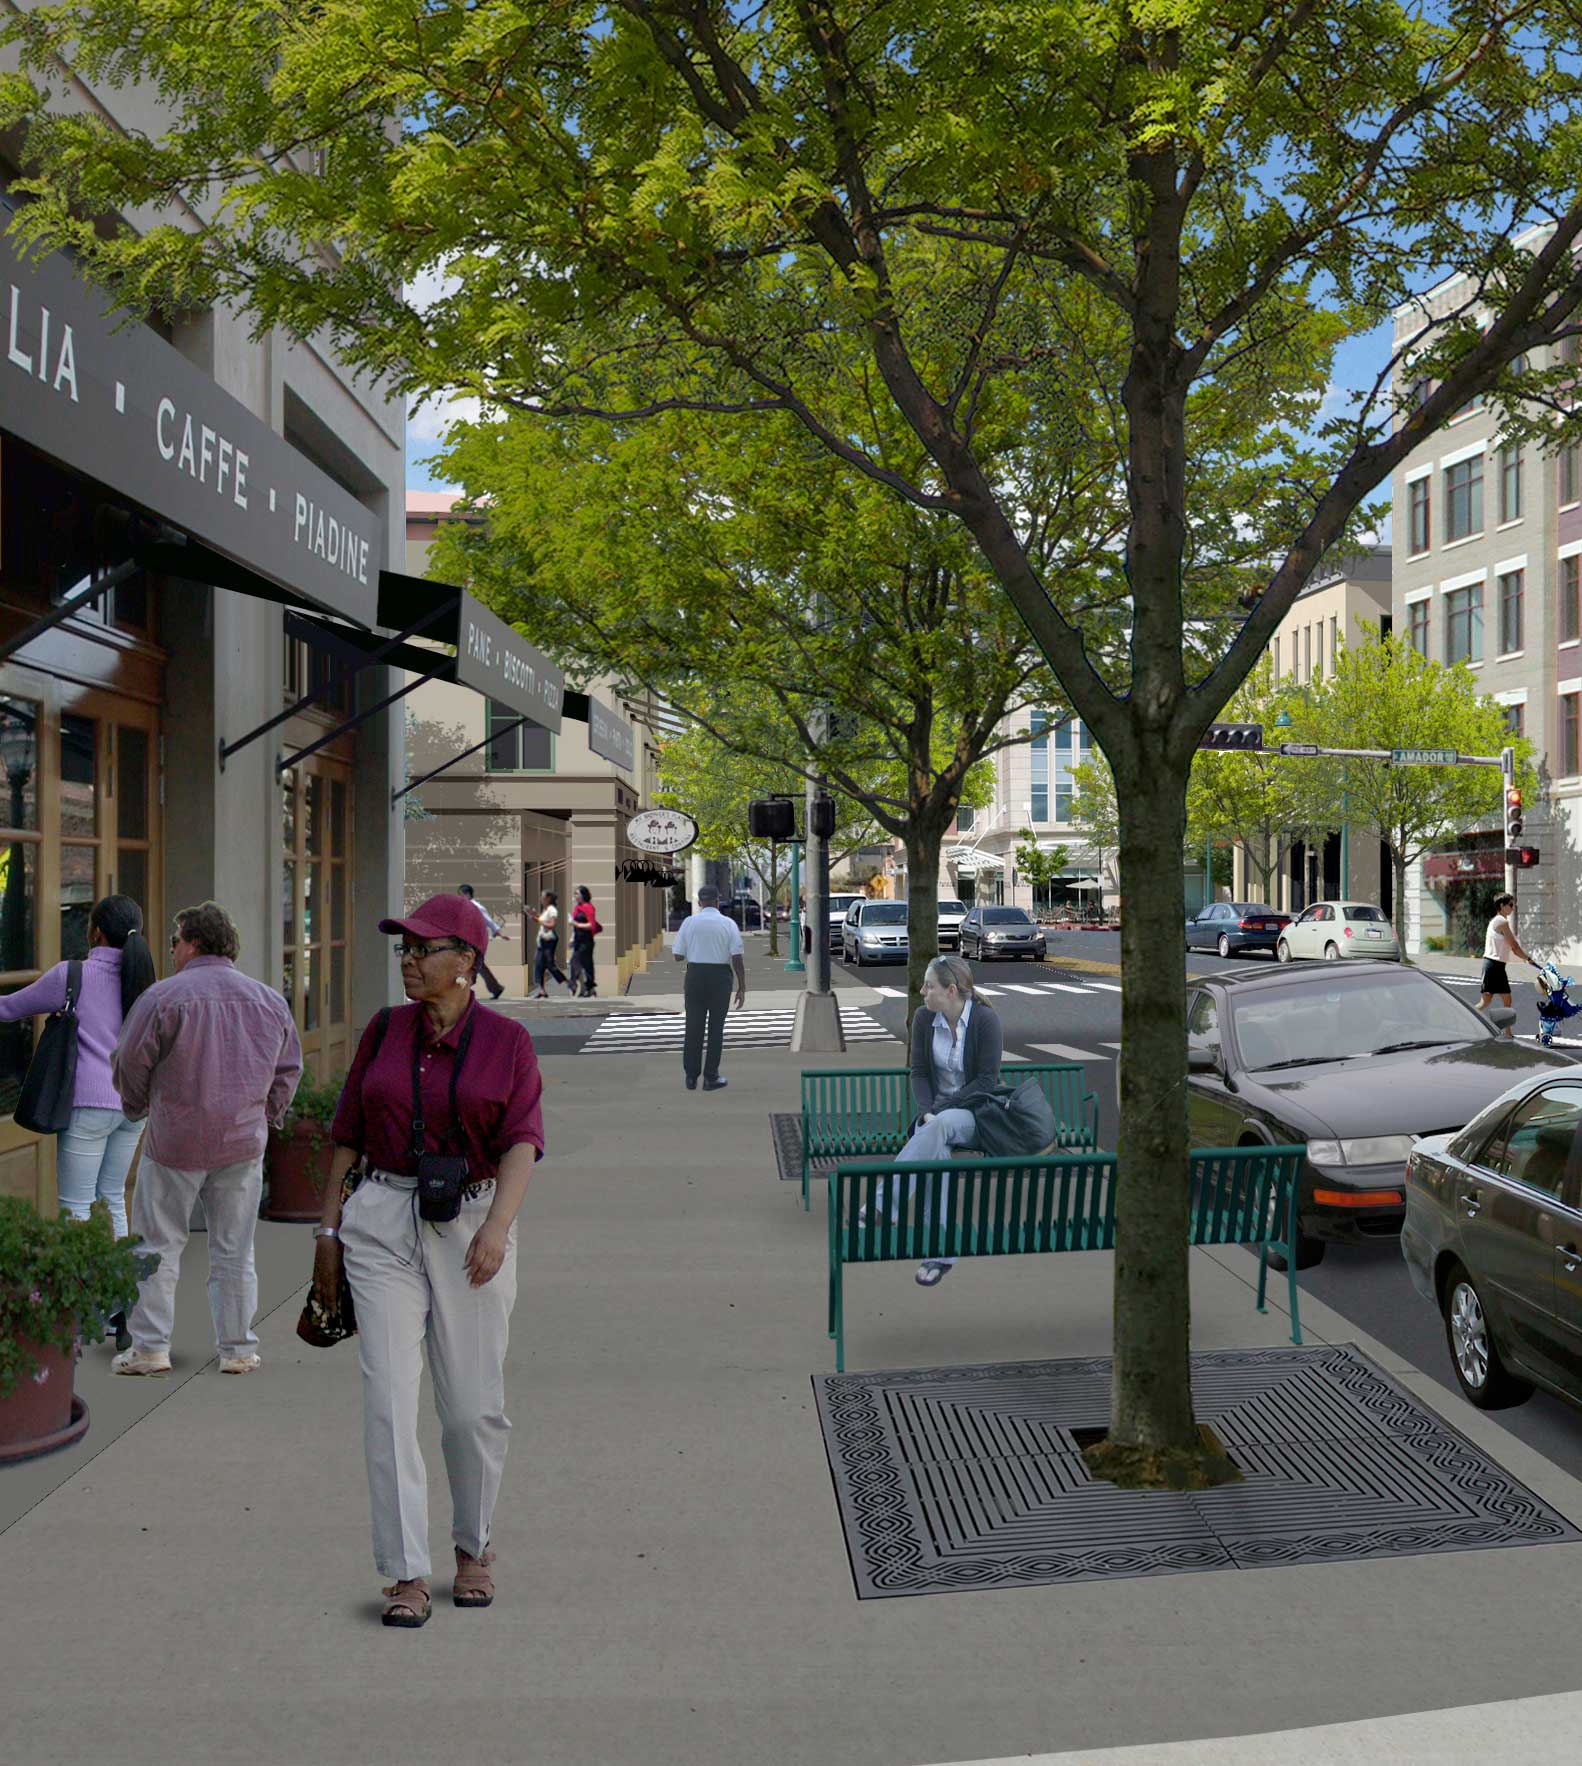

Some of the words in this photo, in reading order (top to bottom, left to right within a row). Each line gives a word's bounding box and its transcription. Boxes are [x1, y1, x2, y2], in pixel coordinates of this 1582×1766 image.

[8, 284, 79, 402] LIA
[156, 397, 249, 511] CAFFE
[294, 492, 369, 585] PIADINE
[467, 622, 491, 667] PANE
[504, 649, 535, 696] BISCOTTI
[1400, 751, 1444, 762] AMADOR
